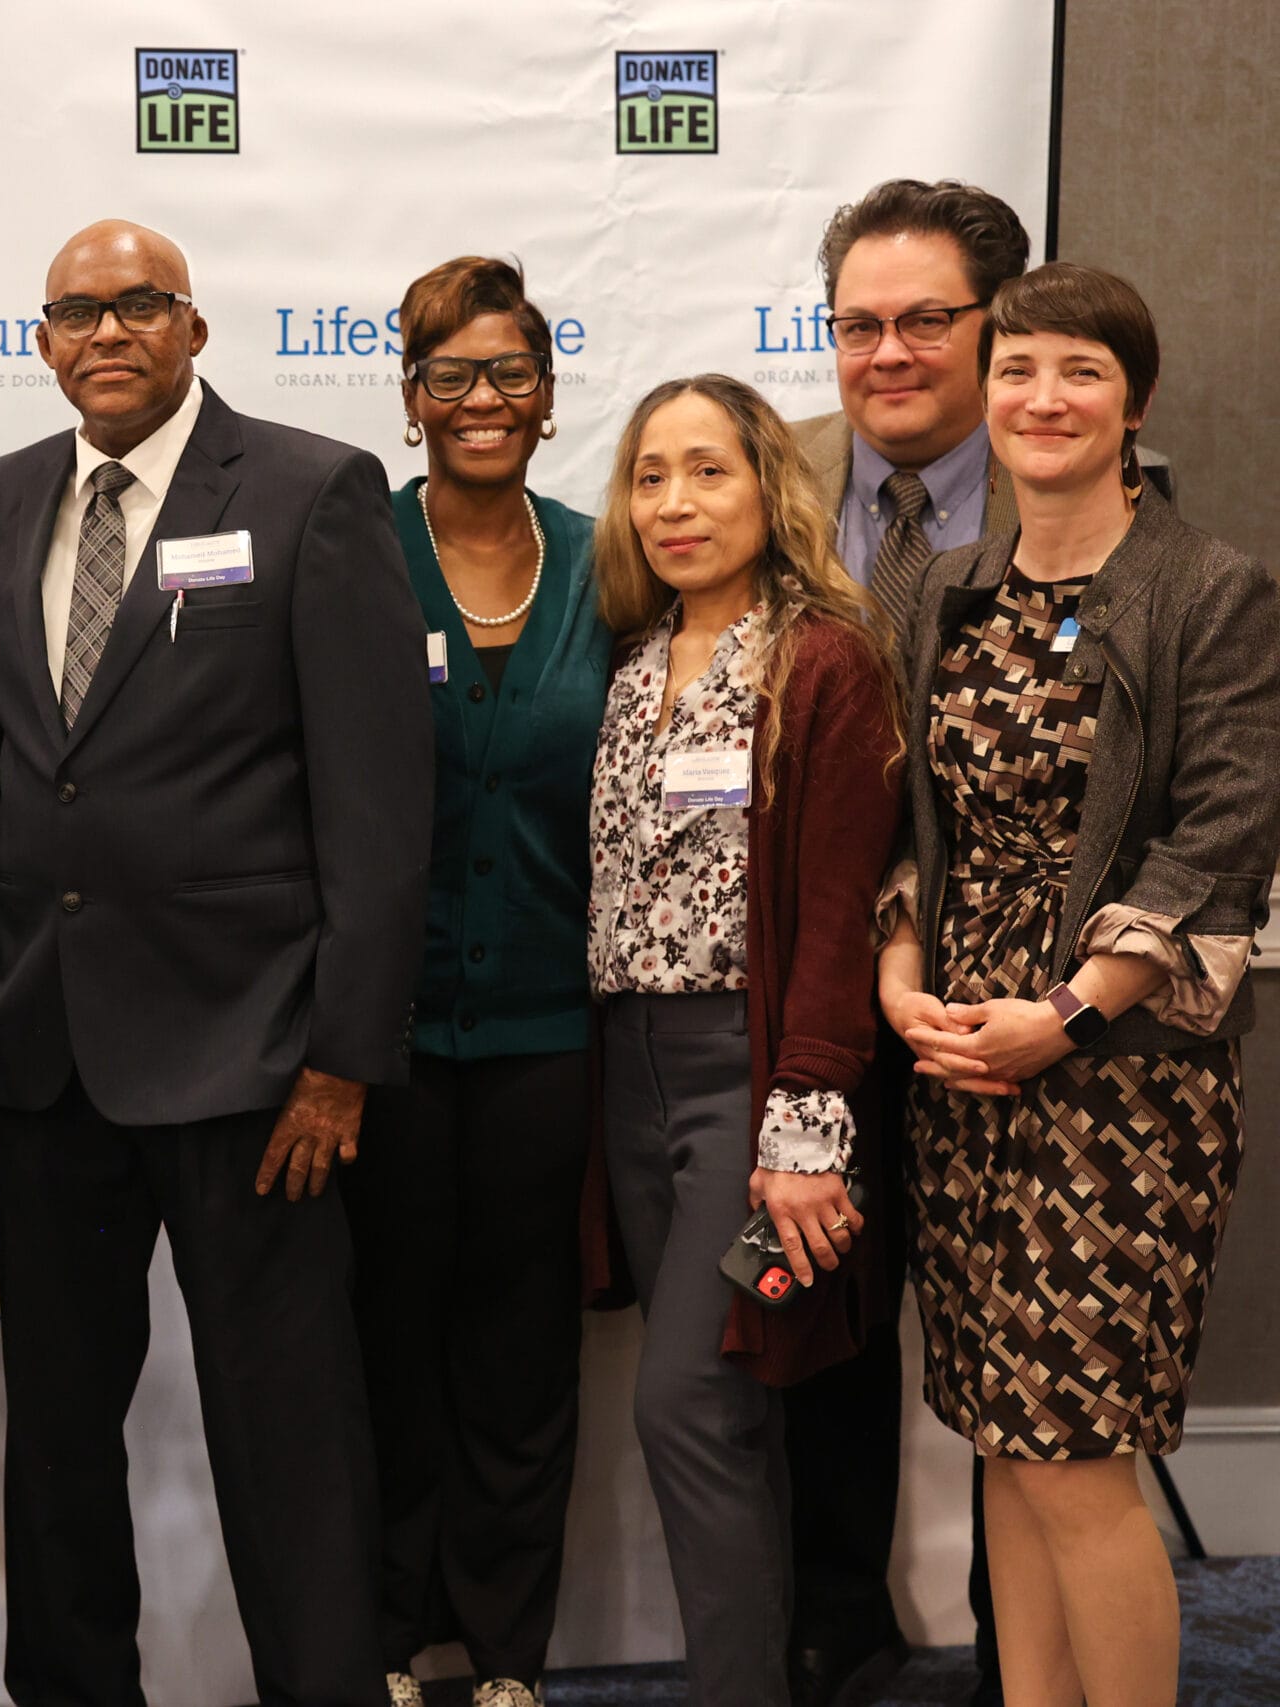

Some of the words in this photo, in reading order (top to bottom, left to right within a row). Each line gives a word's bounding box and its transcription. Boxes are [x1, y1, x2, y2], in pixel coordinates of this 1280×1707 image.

[145, 58, 229, 80] DONATE
[625, 60, 709, 82] DONATE
[147, 103, 230, 143] LIFE
[627, 106, 709, 143] LIFE
[275, 374, 341, 388] ORGAN,
[347, 374, 378, 387] EYE
[754, 369, 820, 384] ORGAN,
